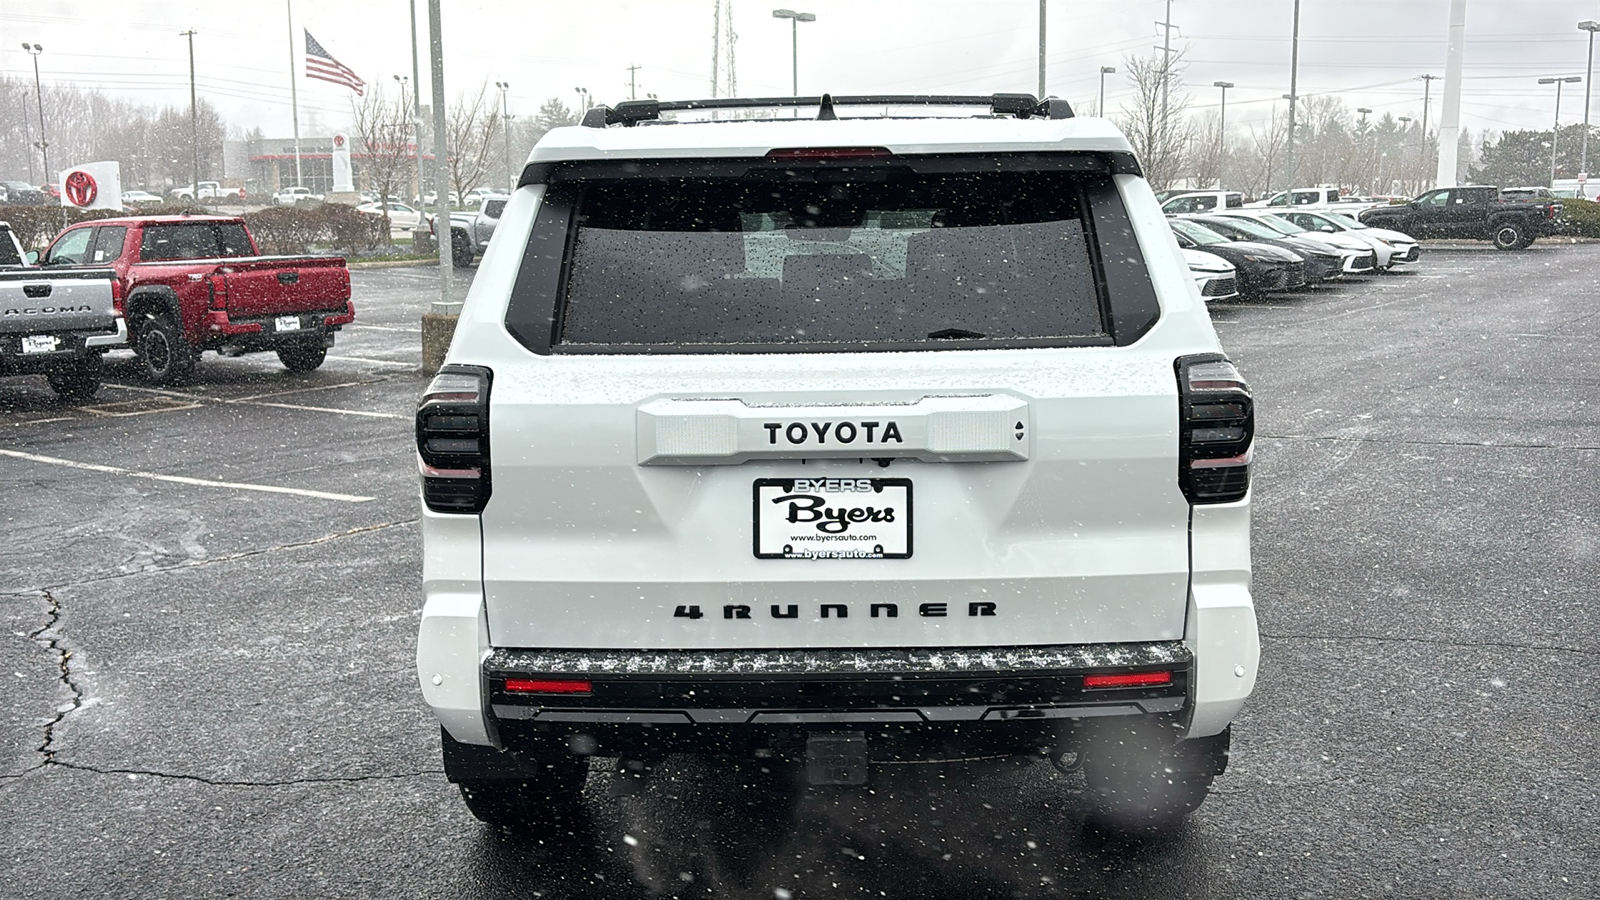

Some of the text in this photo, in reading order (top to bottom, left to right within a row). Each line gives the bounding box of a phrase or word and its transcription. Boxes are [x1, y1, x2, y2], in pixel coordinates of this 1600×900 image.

[763, 421, 903, 444] TOYOTA
[793, 479, 872, 493] BYERS
[771, 494, 895, 534] Byers
[790, 533, 877, 543] www.byersauto.com
[784, 548, 884, 560] www.byersauto.com
[673, 602, 997, 619] 4RUNNER
